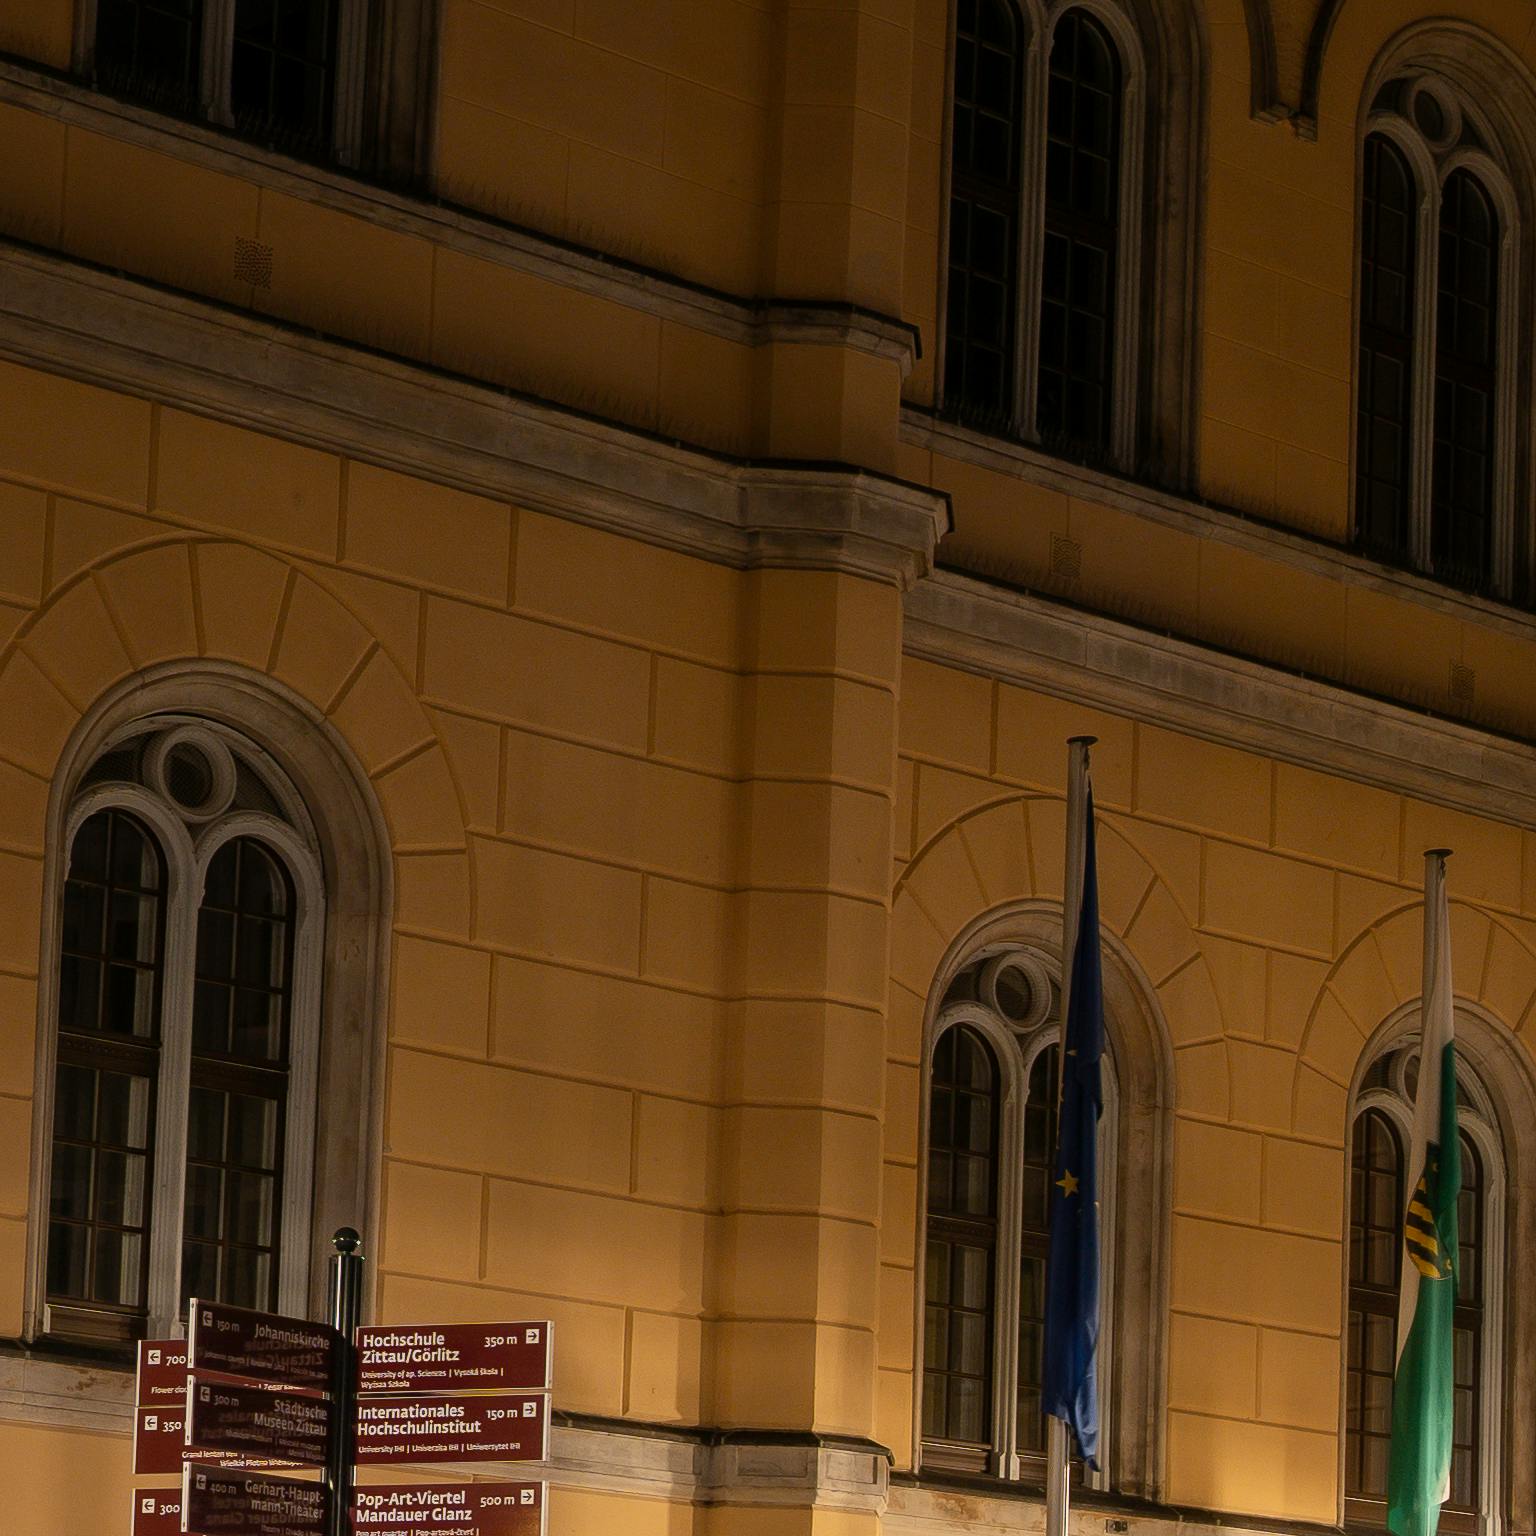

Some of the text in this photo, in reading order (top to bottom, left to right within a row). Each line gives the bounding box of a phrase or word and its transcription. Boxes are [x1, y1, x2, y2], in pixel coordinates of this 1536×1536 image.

[216, 1320, 230, 1331] 150
[254, 1323, 331, 1350] Johanniskirche
[363, 1332, 445, 1348] Hochschule
[484, 1335, 518, 1348] 350 m
[165, 1355, 186, 1367] 700
[361, 1347, 460, 1364] Zittau/Görlitz
[361, 1370, 397, 1380] University
[274, 1400, 328, 1420] Städtische
[358, 1403, 465, 1420] Internationales
[486, 1408, 518, 1420] 150 m
[162, 1421, 182, 1433] 350
[253, 1412, 295, 1431] Museen
[295, 1417, 328, 1436] Zittau
[357, 1419, 482, 1436] Hochschulinstitut
[244, 1480, 325, 1503] Gerhart-Haupt-
[357, 1490, 466, 1508] Pop-Art-Viertel
[159, 1504, 180, 1515] 300
[251, 1499, 324, 1520] mann-Theater
[480, 1496, 515, 1508] 500 m
[356, 1507, 473, 1523] Mandauer Glanz
